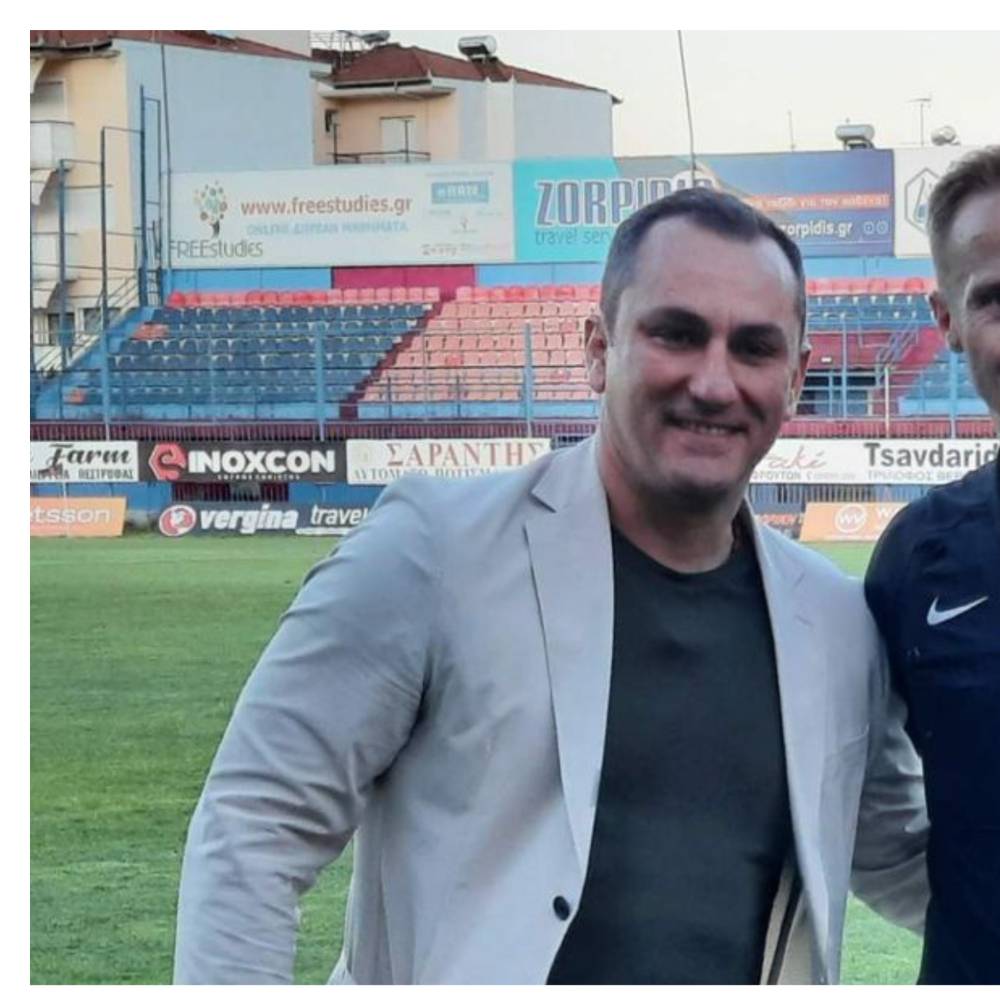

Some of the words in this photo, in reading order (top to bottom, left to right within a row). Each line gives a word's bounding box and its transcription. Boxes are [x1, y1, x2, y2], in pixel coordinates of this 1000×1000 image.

[240, 194, 412, 216] www.freestudies.gr
[47, 443, 132, 466] Farm
[188, 450, 335, 473] INOXCON
[30, 506, 111, 524] tsson
[200, 503, 299, 535] vergina
